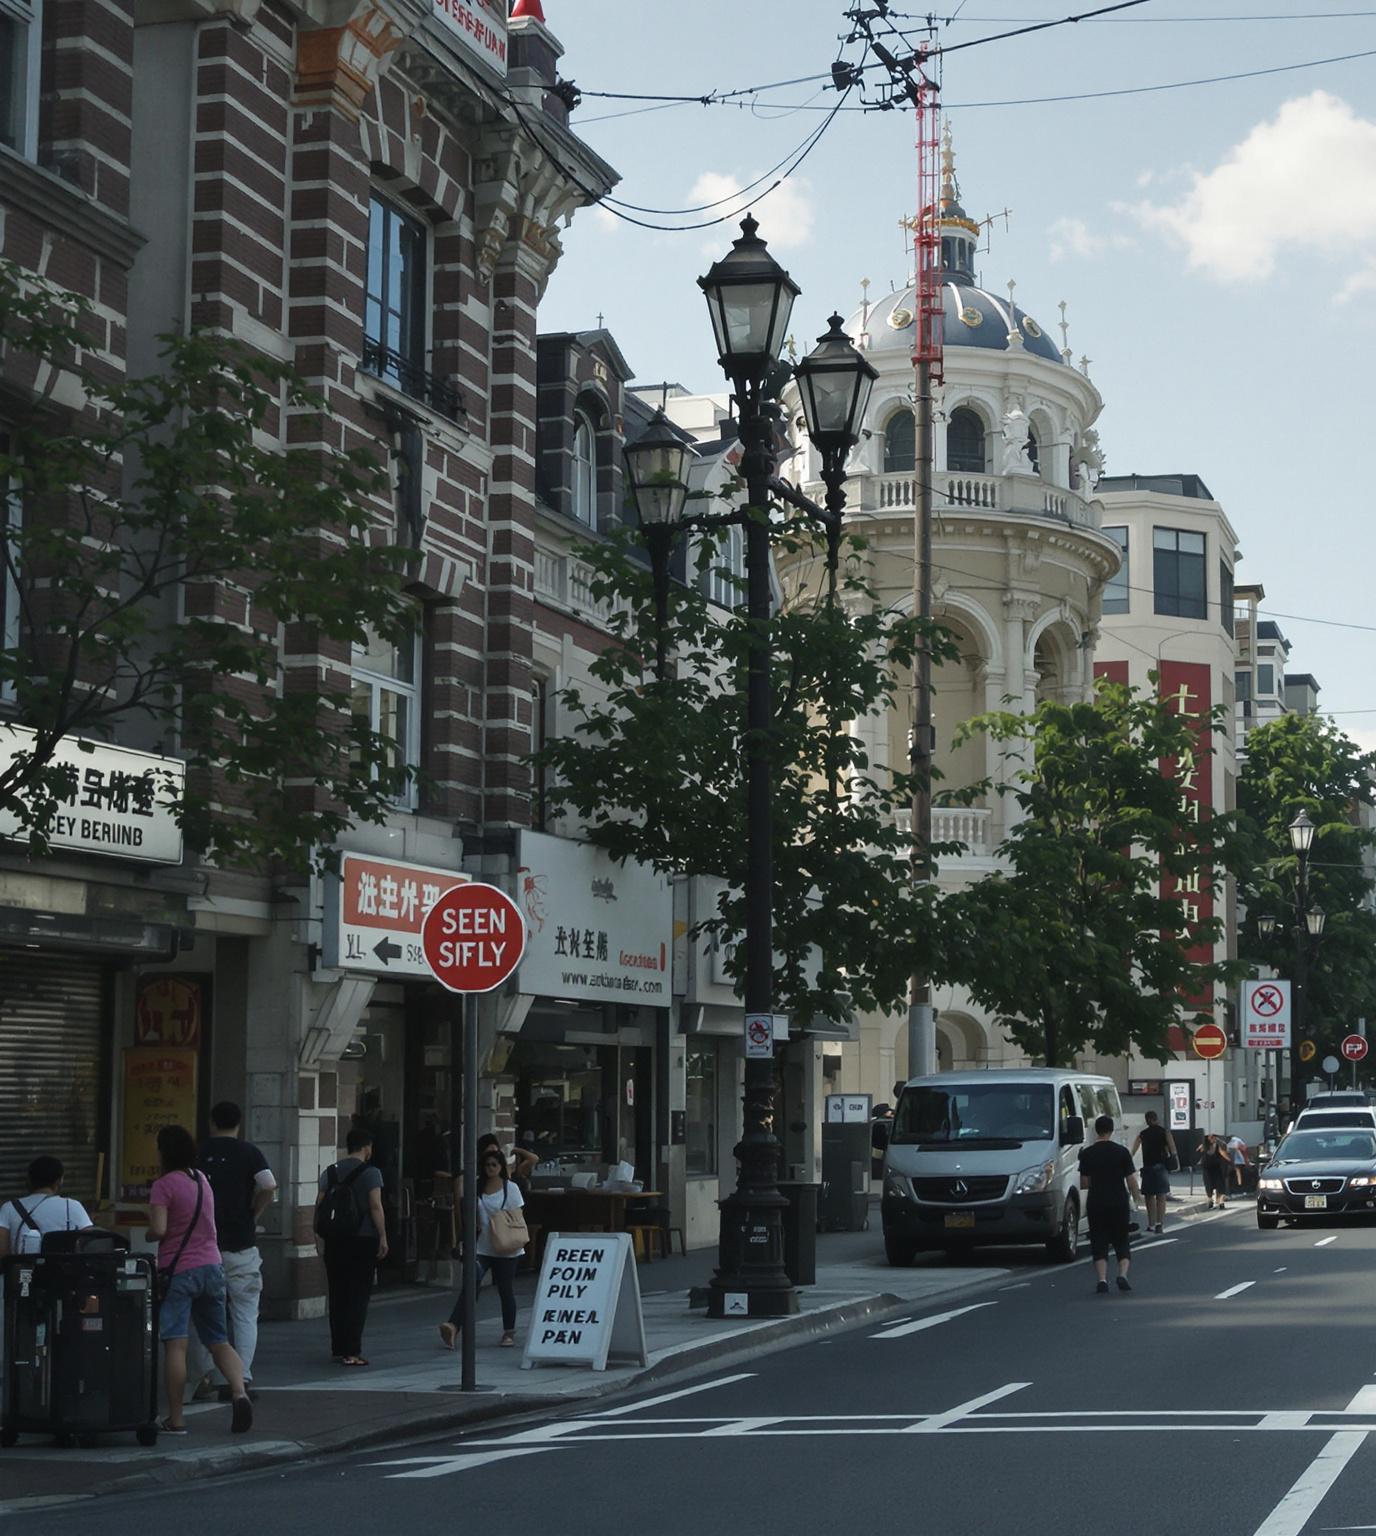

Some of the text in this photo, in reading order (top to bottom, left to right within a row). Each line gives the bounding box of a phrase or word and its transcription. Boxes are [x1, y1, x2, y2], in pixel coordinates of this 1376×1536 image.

[441, 908, 506, 935] SEEN
[439, 941, 507, 968] SIFLY
[547, 1284, 588, 1299] PILY
